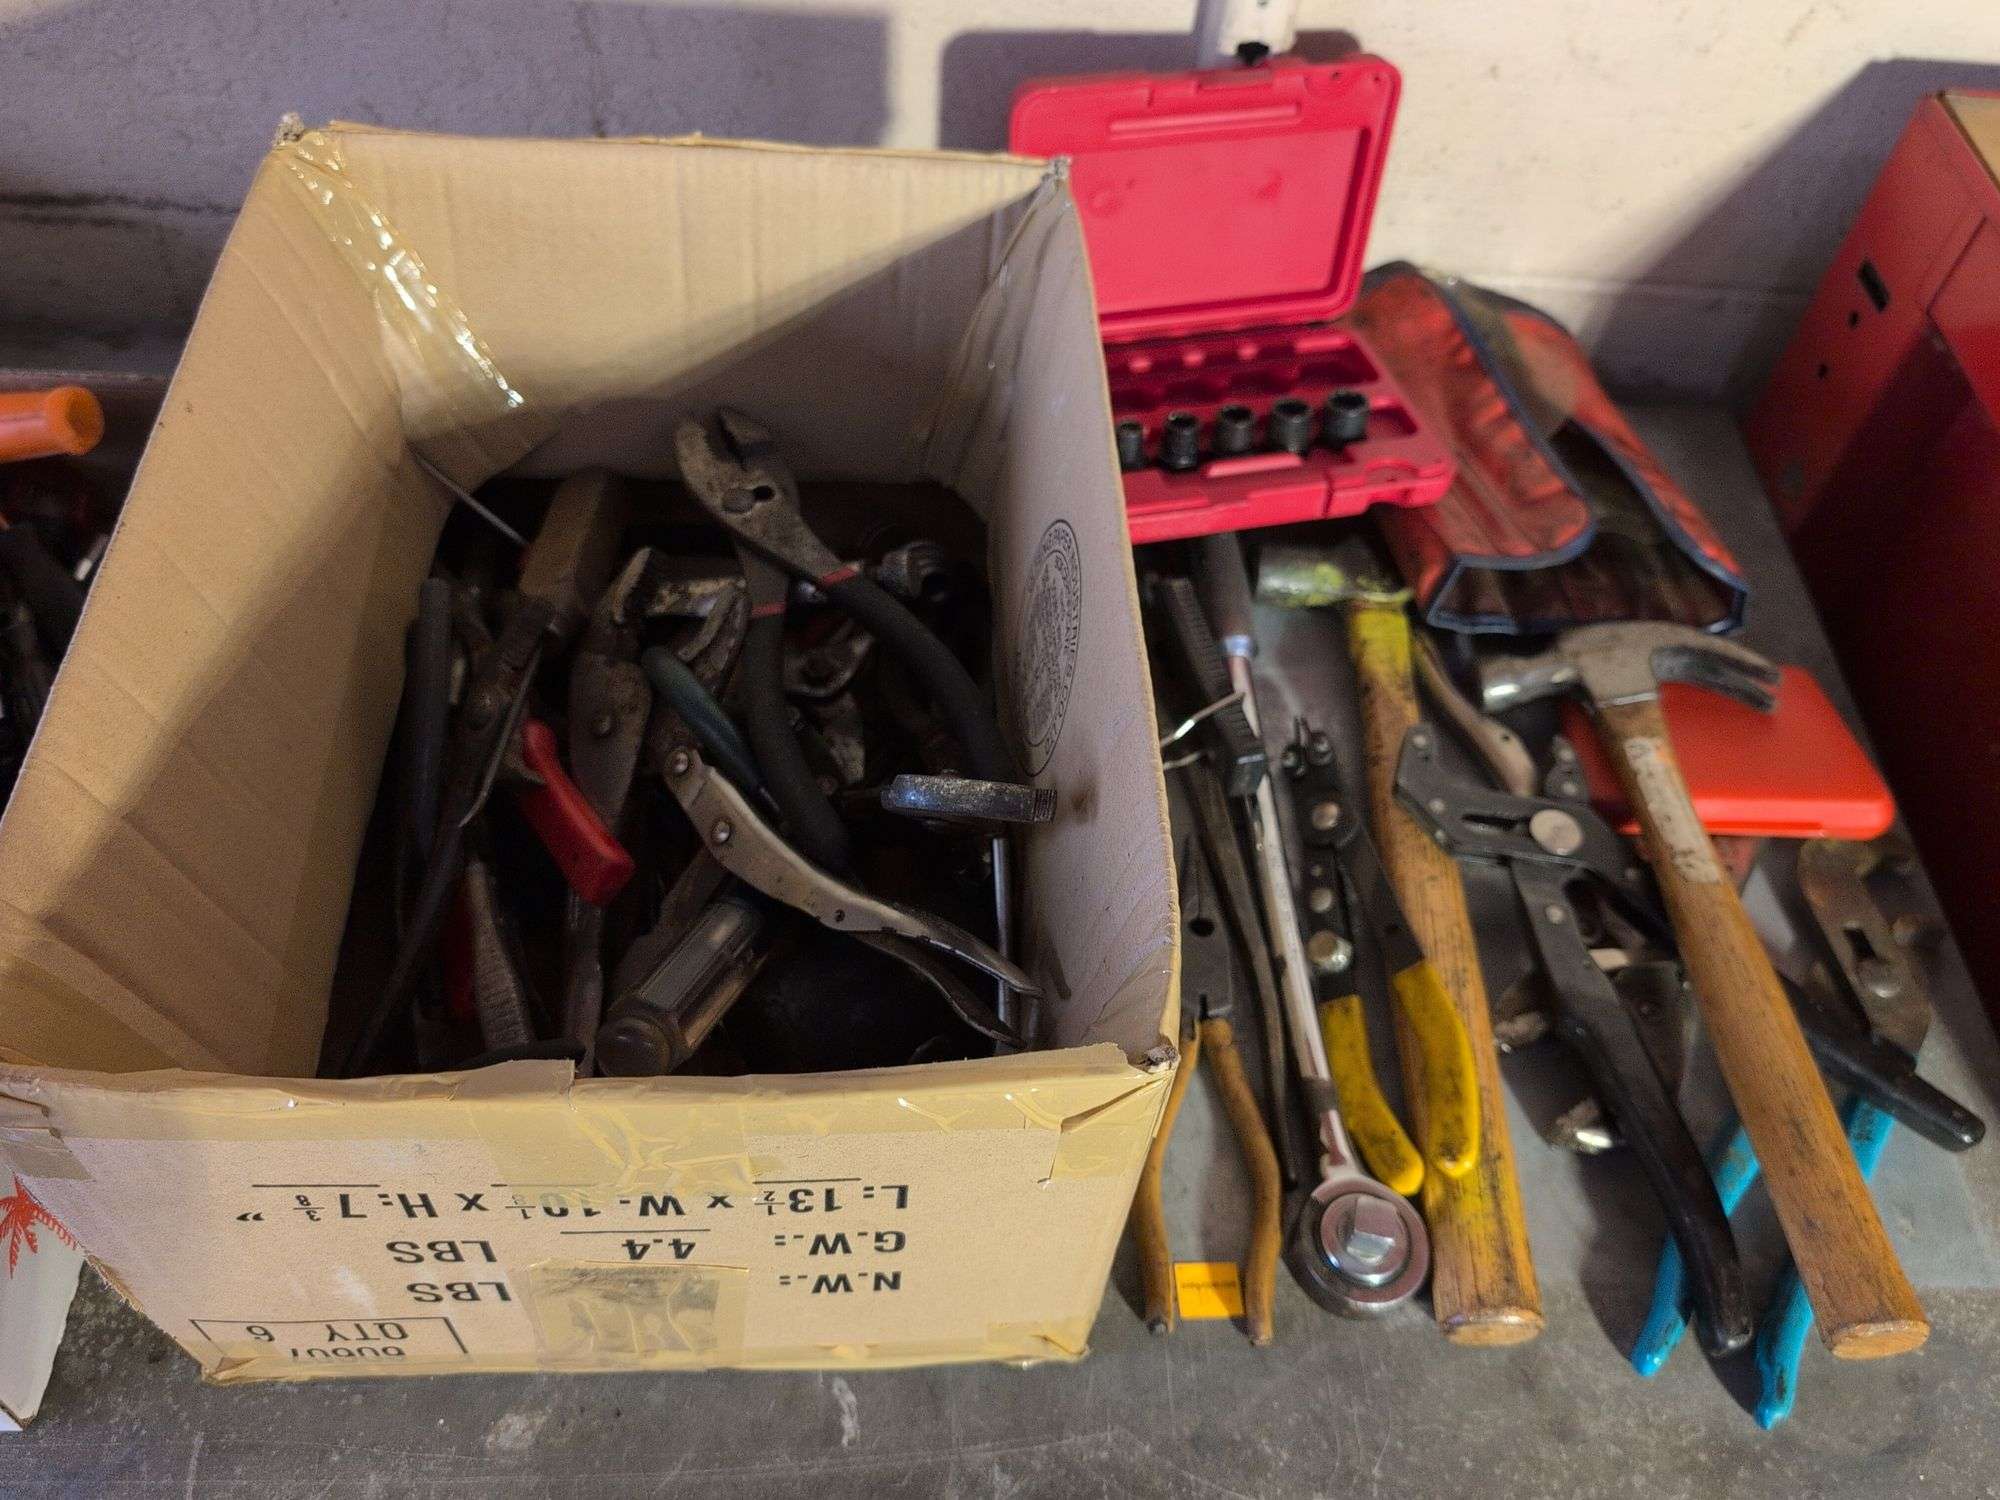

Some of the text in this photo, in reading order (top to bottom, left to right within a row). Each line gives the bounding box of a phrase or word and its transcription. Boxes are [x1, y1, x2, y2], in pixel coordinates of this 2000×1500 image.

[454, 1193, 489, 1211] x
[385, 1240, 498, 1264] LBS
[621, 1238, 696, 1260] 4.4
[406, 1281, 512, 1303] LBS
[246, 1322, 408, 1341] QTY 6
